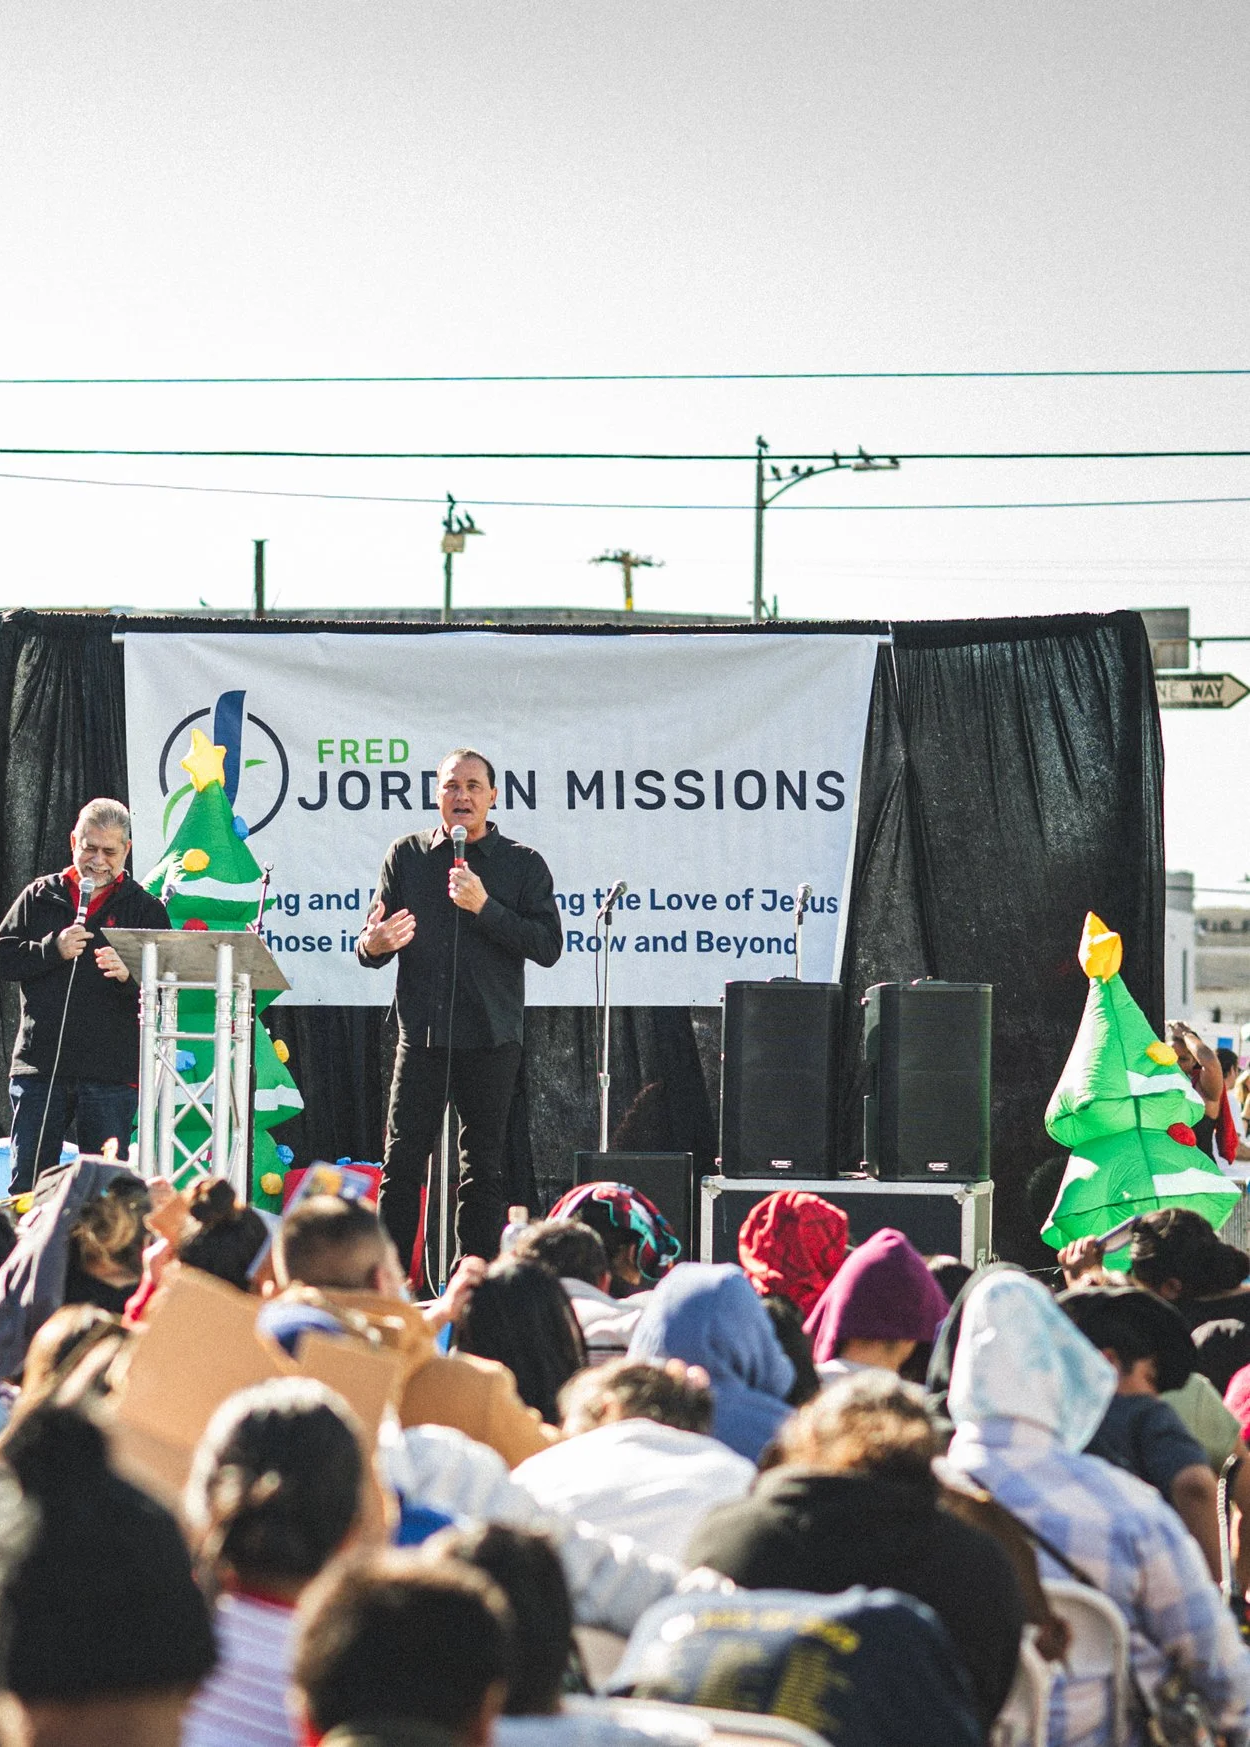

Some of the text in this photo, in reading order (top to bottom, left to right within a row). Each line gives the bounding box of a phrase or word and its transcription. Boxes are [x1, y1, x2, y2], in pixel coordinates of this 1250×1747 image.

[1157, 683, 1224, 699] NE WAY
[317, 738, 410, 764] FRED
[297, 769, 846, 812] JORDN MISSIONS
[308, 888, 360, 911] and
[649, 888, 717, 911] Love
[724, 888, 754, 911] of
[260, 930, 333, 953] hose
[566, 930, 627, 953] Row
[634, 930, 687, 953] and
[696, 930, 797, 959] Beyond
